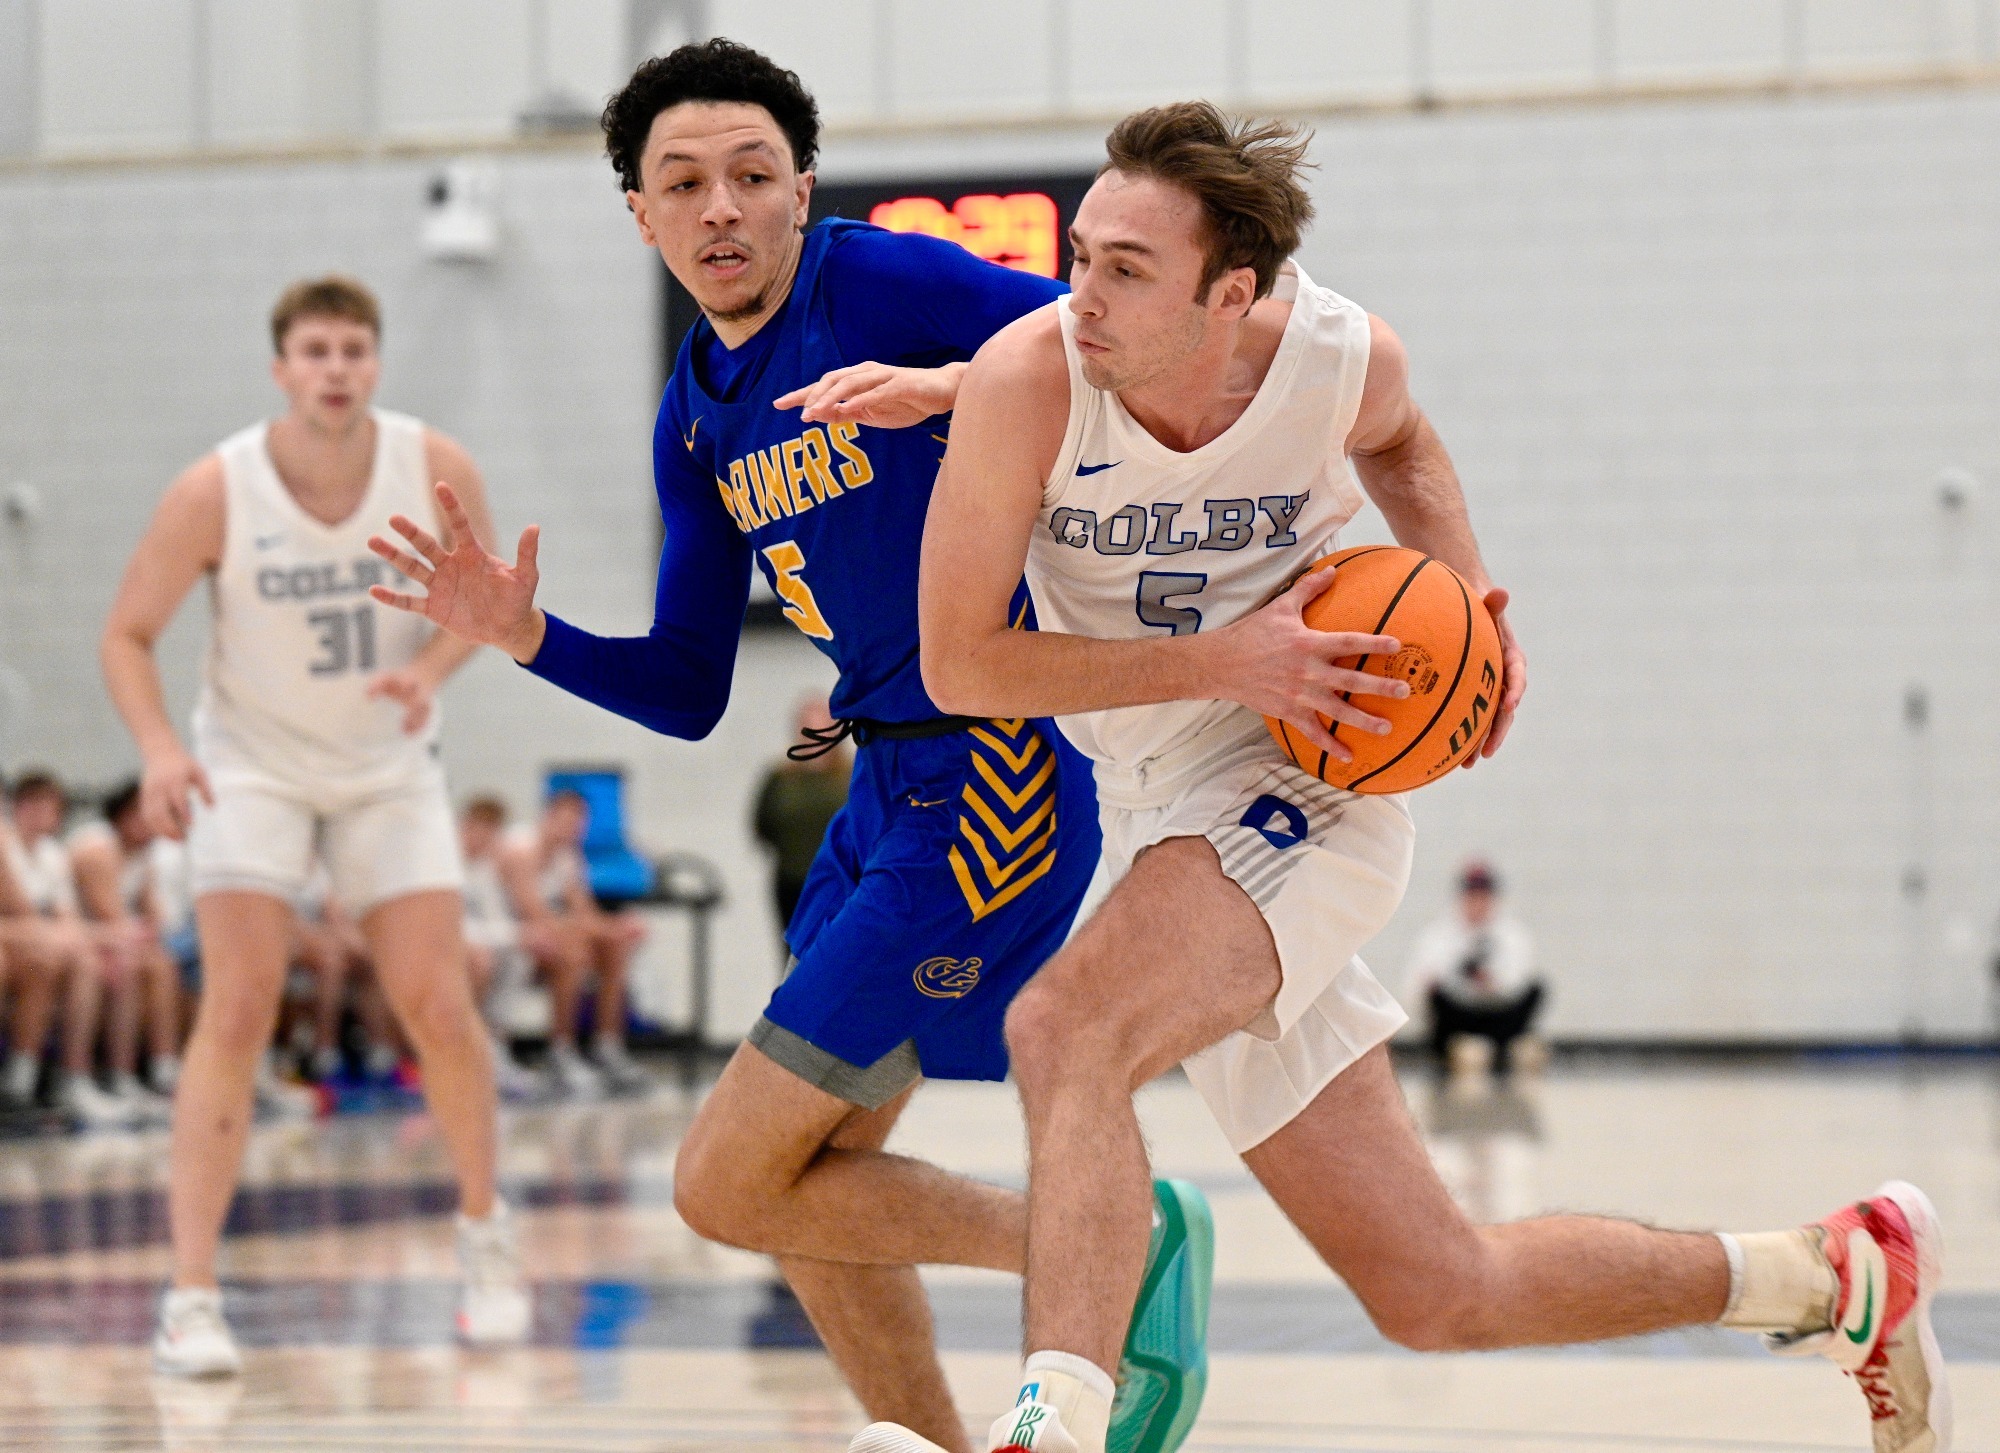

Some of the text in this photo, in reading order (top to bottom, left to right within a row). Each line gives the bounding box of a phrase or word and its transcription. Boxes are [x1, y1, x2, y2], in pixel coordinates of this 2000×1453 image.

[1049, 489, 1311, 555] COLBY
[761, 540, 834, 641] 5
[1136, 571, 1208, 637] 5
[308, 605, 376, 674] 31
[1448, 659, 1496, 755] EVO
